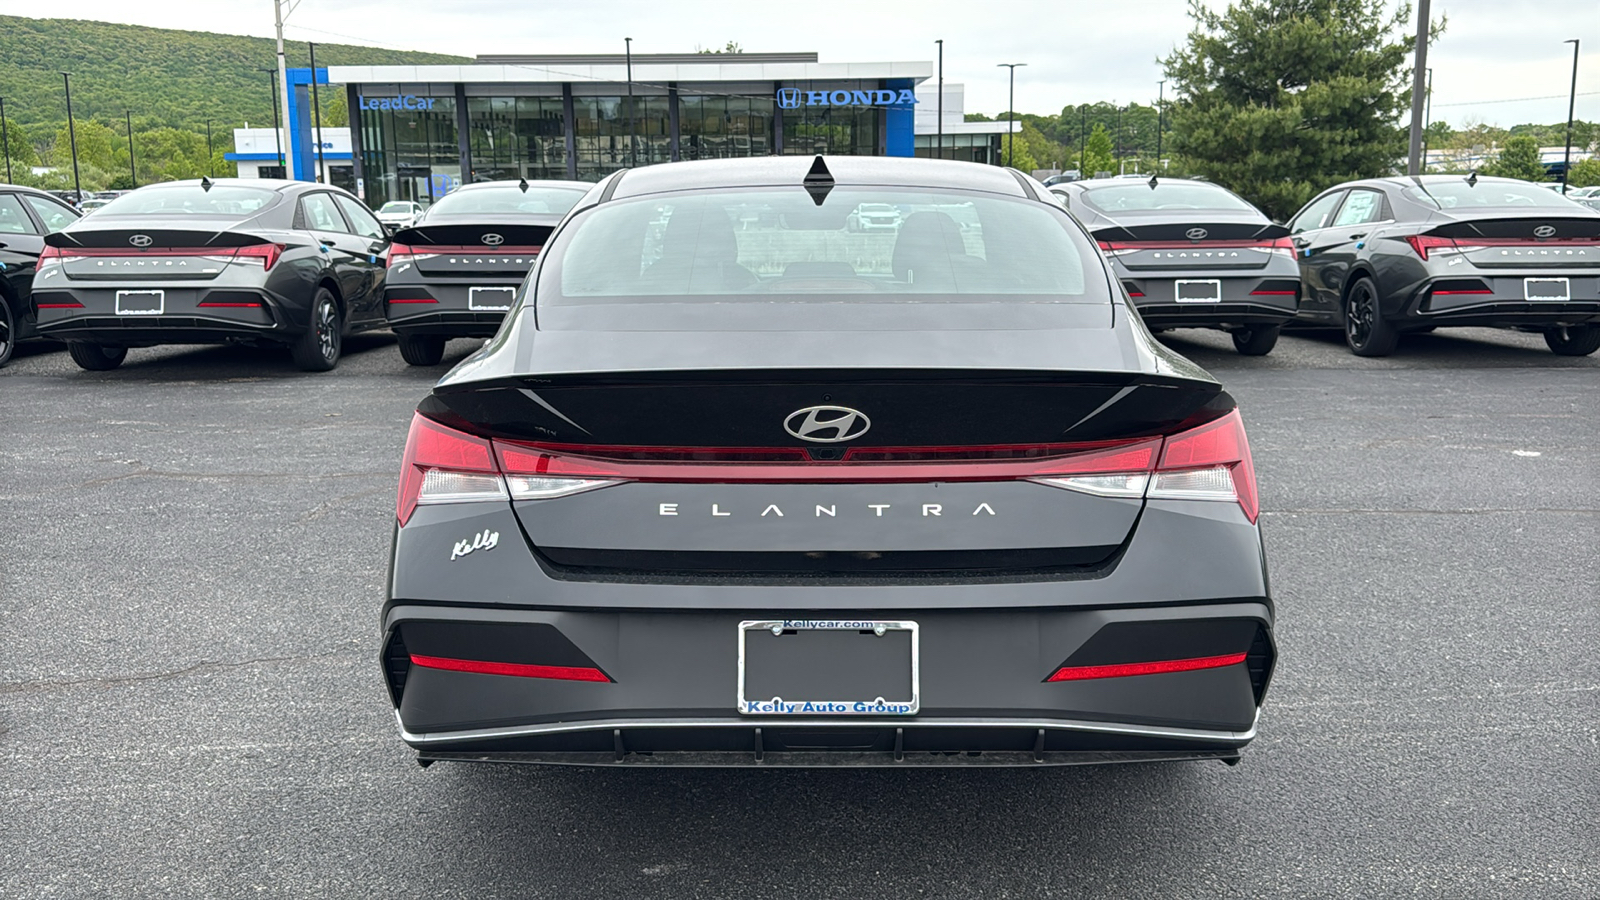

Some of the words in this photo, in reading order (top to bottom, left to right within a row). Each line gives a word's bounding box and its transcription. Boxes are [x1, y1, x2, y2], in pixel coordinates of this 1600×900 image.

[359, 94, 435, 111] LeadCar
[806, 89, 920, 106] HONDA
[659, 503, 996, 517] ELANTRA
[450, 529, 499, 560] Kelly
[783, 619, 874, 629] Kellycar.com
[748, 701, 796, 713] Kelly
[802, 701, 847, 713] Auto
[853, 701, 910, 714] Group
